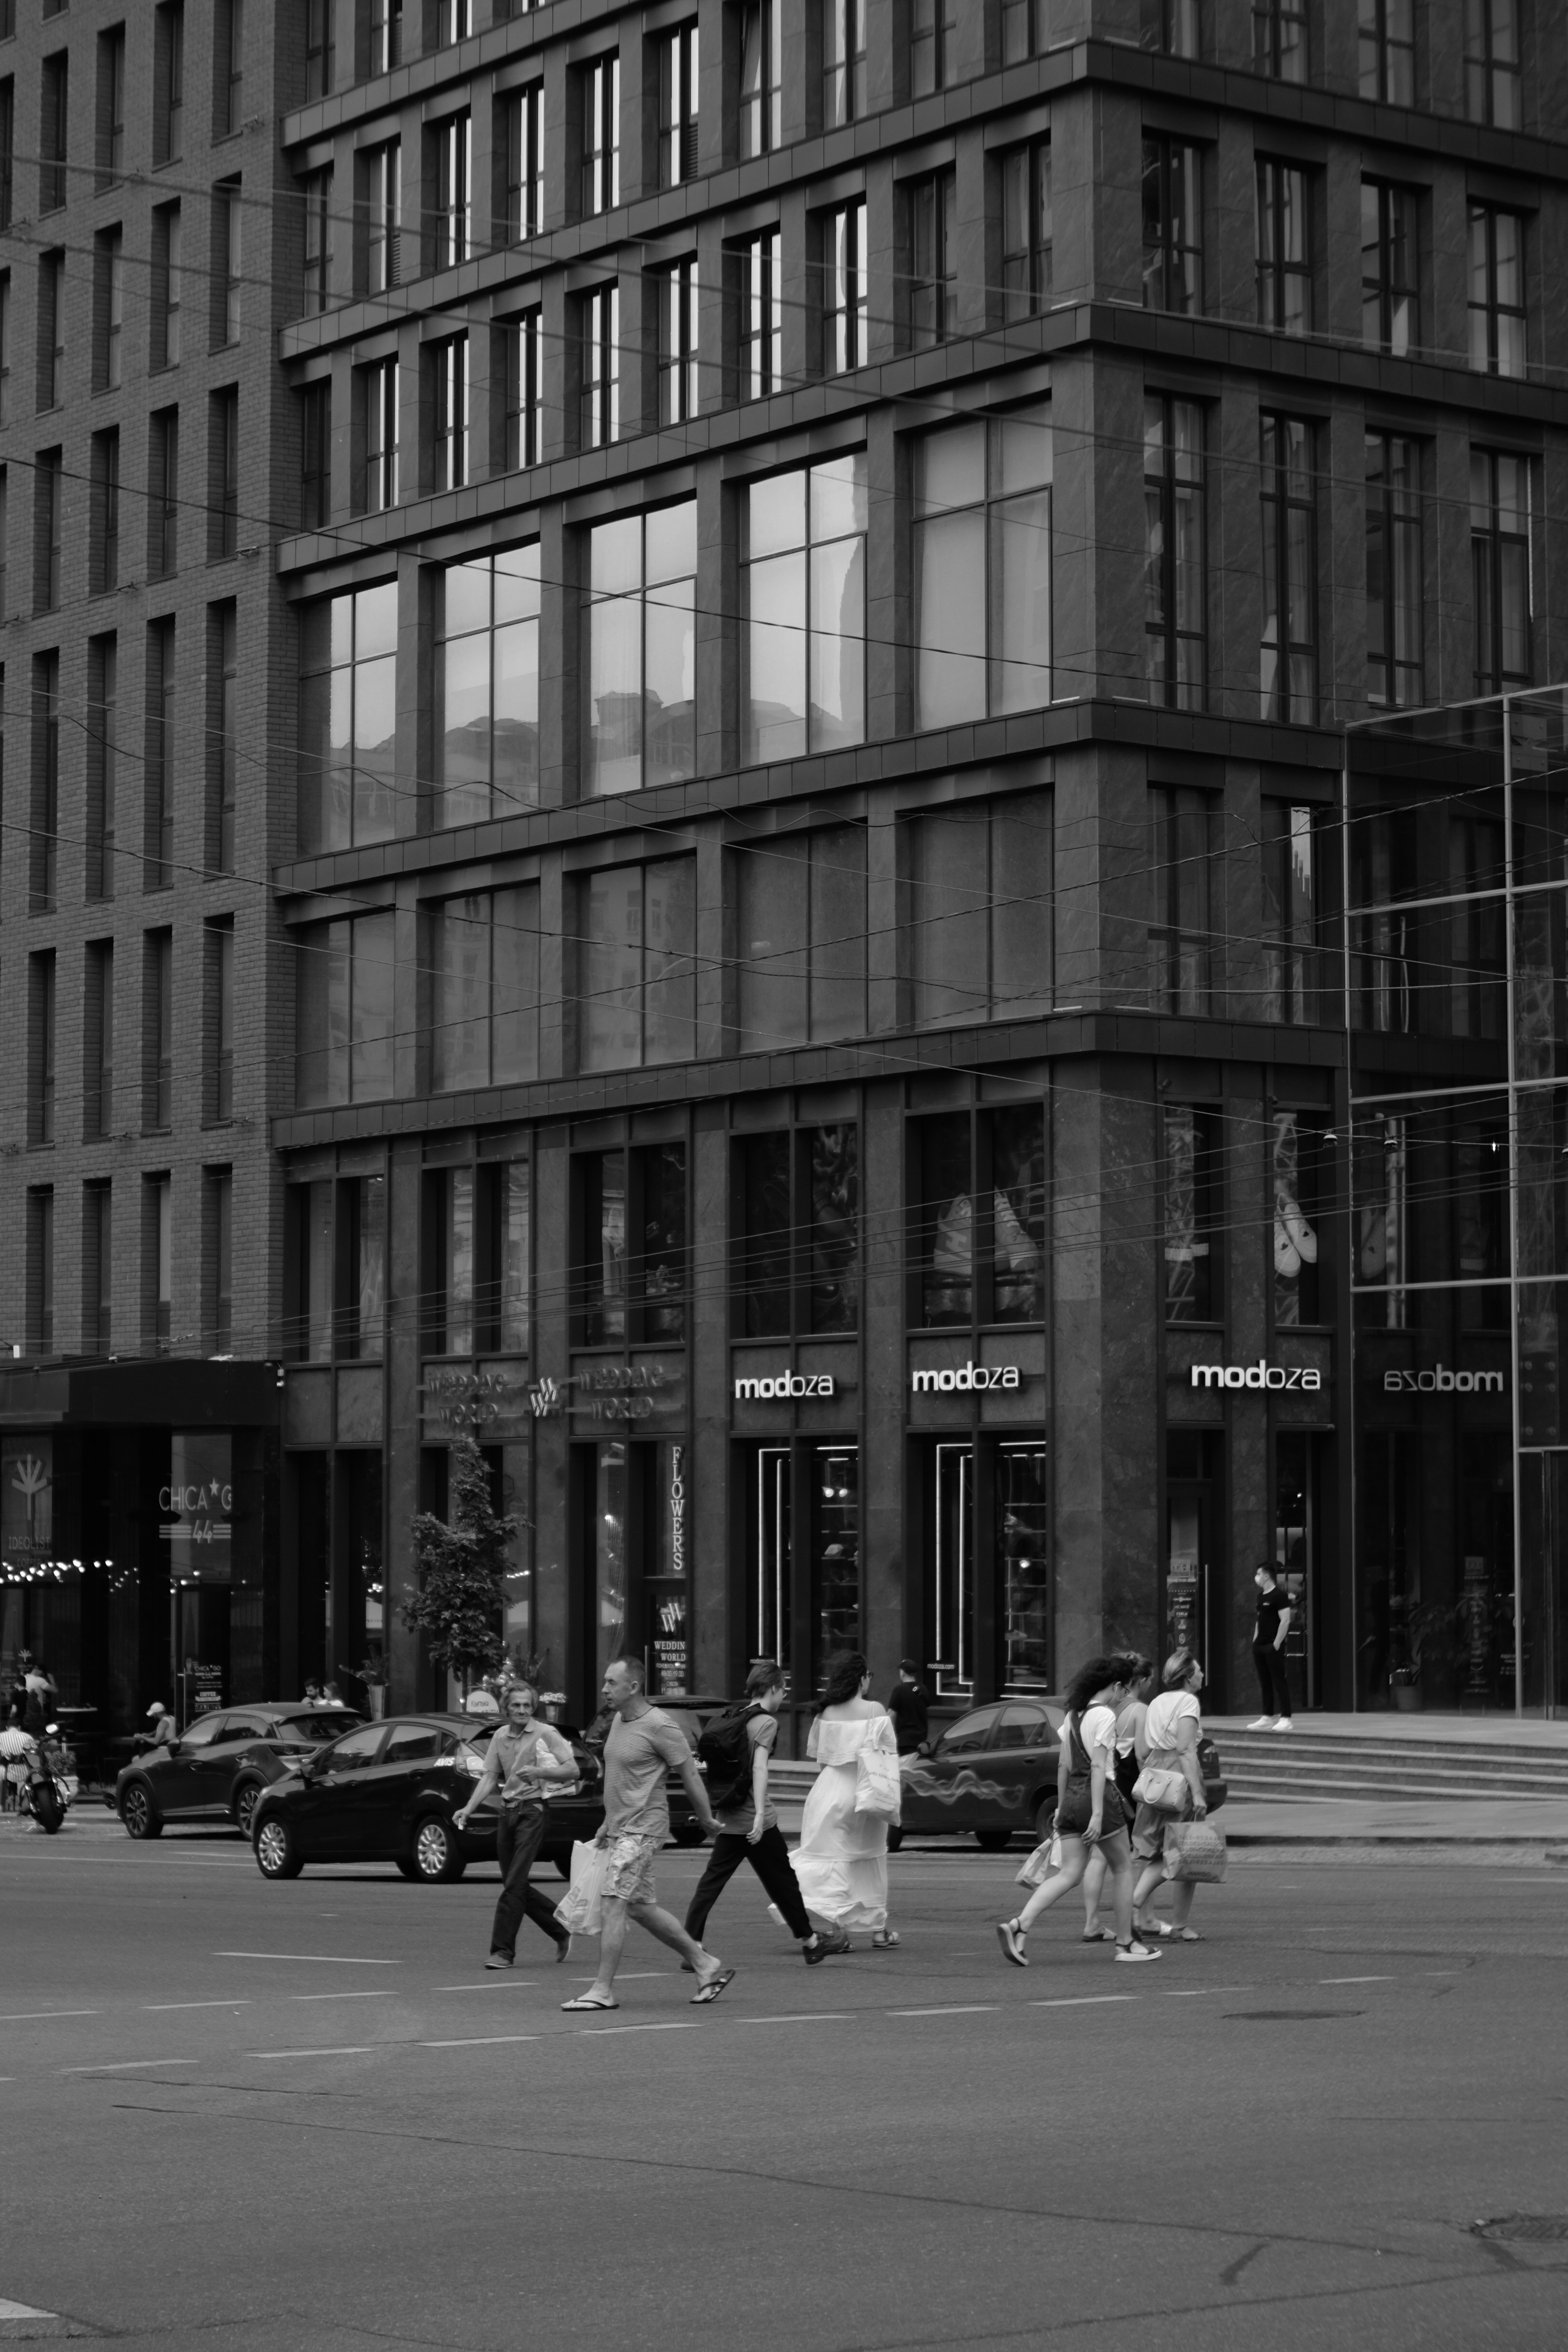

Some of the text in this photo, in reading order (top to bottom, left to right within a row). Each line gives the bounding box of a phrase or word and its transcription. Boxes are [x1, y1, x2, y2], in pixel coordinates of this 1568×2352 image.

[428, 1374, 507, 1395] WEDDING
[579, 1366, 664, 1390] WEDDING
[735, 1370, 833, 1399] modoza
[913, 1361, 1020, 1391] modoza
[1191, 1360, 1321, 1390] modoza
[438, 1403, 499, 1424] WORLD
[589, 1397, 654, 1420] WORLD
[670, 1446, 686, 1570] FLOWERS
[9, 1536, 50, 1550] IDEOLIST
[660, 1653, 686, 1661] WORLD
[434, 1757, 455, 1767] AVIS
